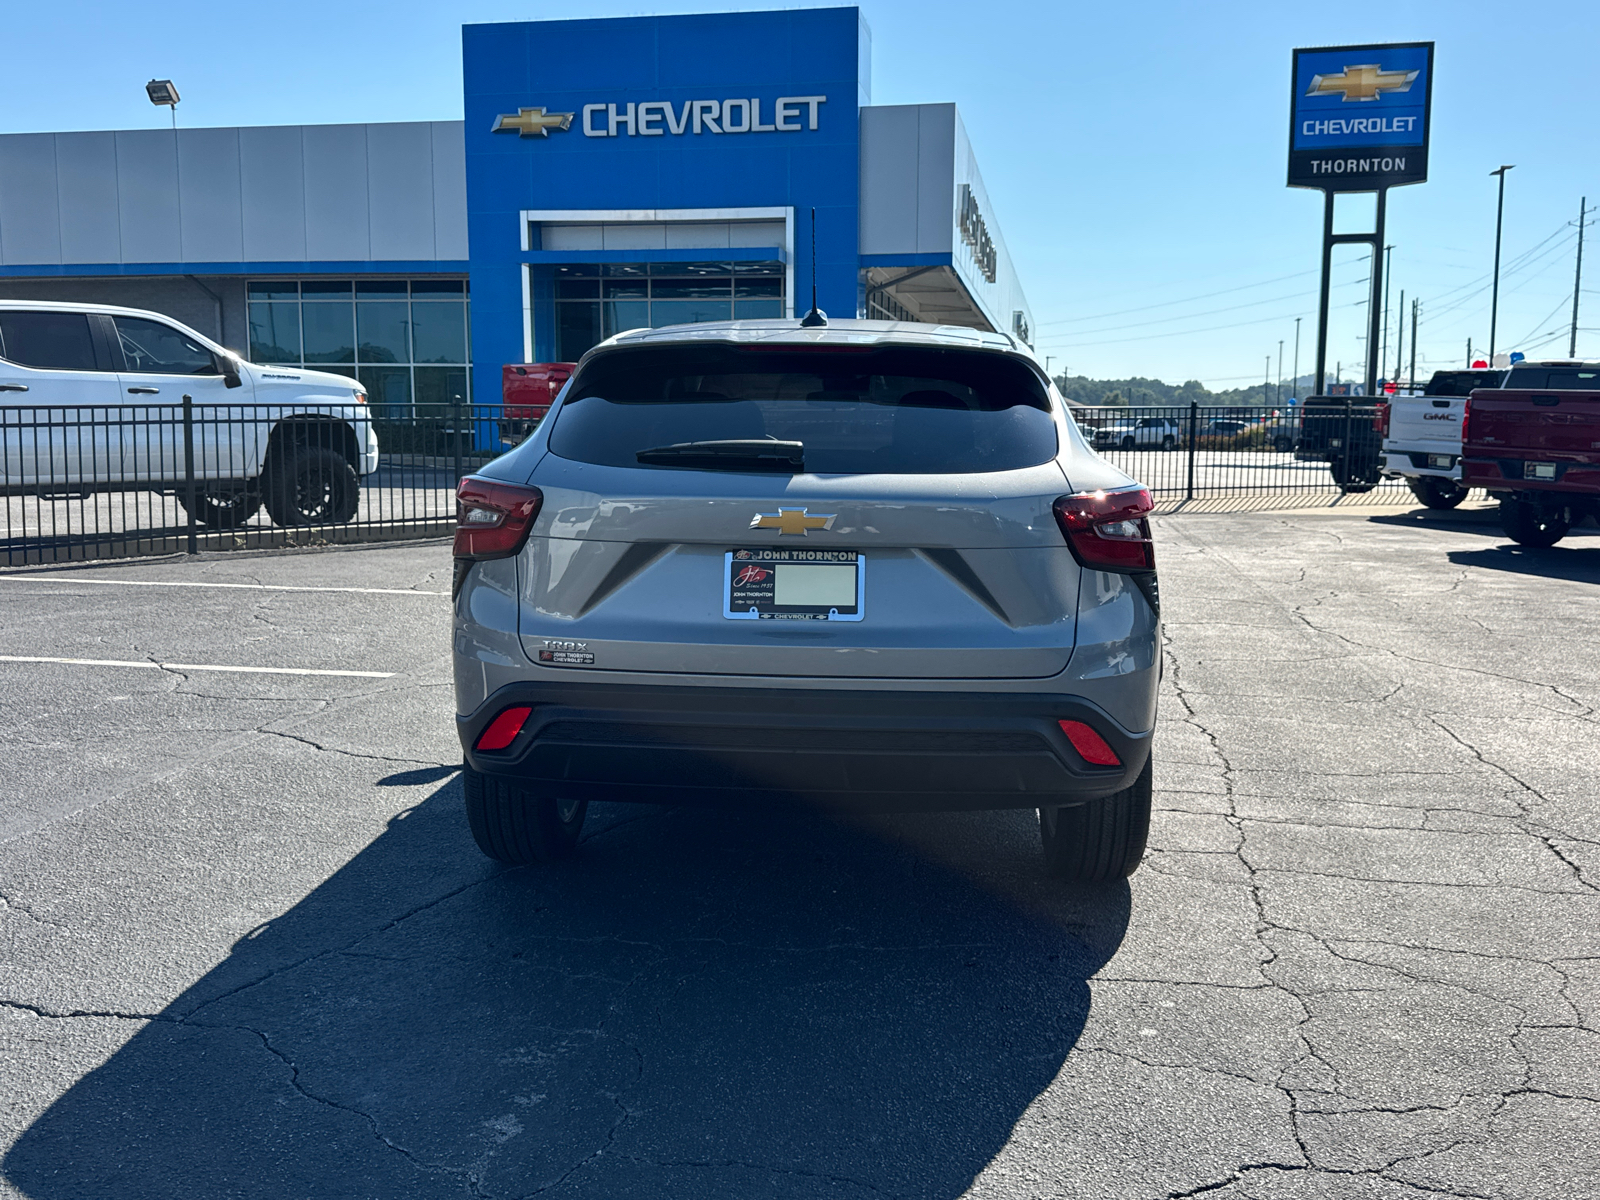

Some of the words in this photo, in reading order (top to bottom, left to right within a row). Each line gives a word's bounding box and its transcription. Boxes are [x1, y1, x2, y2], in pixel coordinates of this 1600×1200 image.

[582, 95, 827, 137] CHEVROLET
[1302, 116, 1417, 135] CHEVROLET
[1310, 157, 1406, 174] THORNTON
[1423, 412, 1457, 422] GMC
[757, 550, 789, 560] JOHN
[792, 551, 857, 561] THORNTON
[542, 640, 589, 651] TRAX
